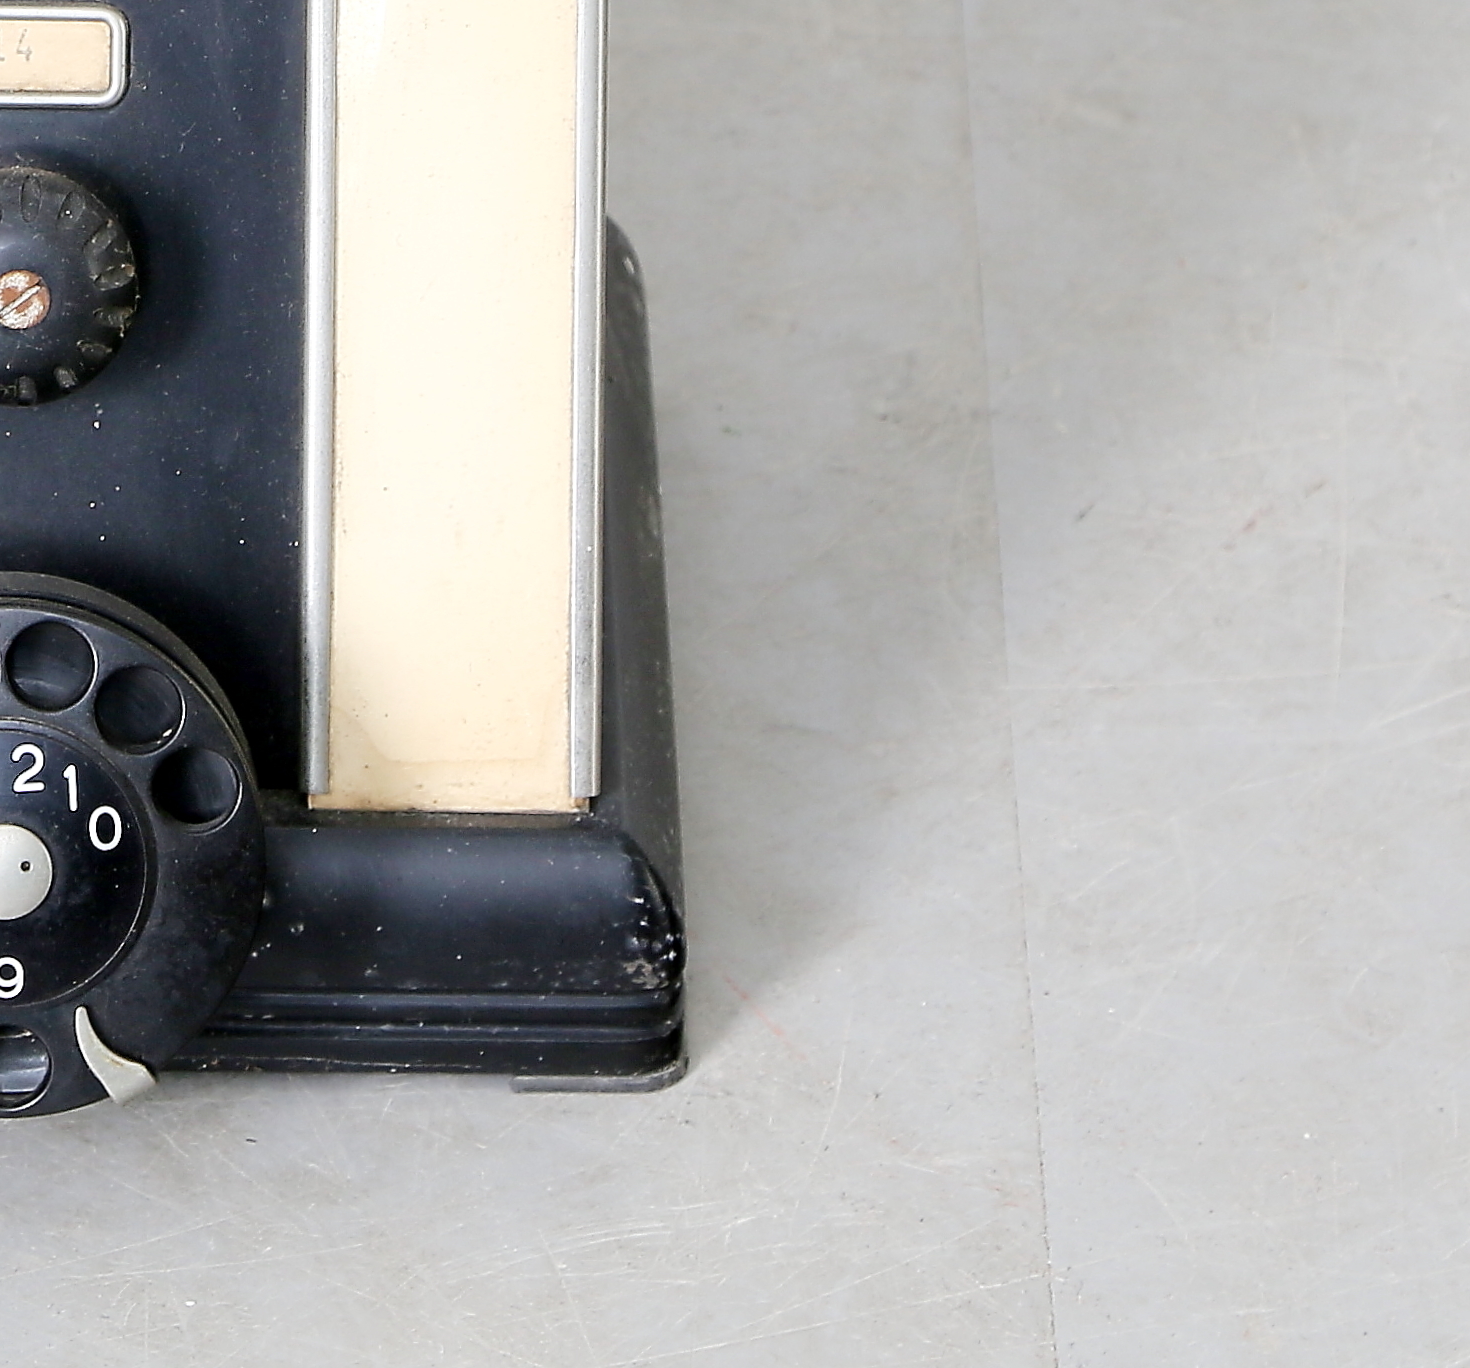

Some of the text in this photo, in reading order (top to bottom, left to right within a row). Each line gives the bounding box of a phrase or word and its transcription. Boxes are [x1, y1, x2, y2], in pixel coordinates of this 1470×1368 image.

[10, 742, 46, 793] 2
[62, 764, 79, 812] 1
[88, 804, 122, 852] 0
